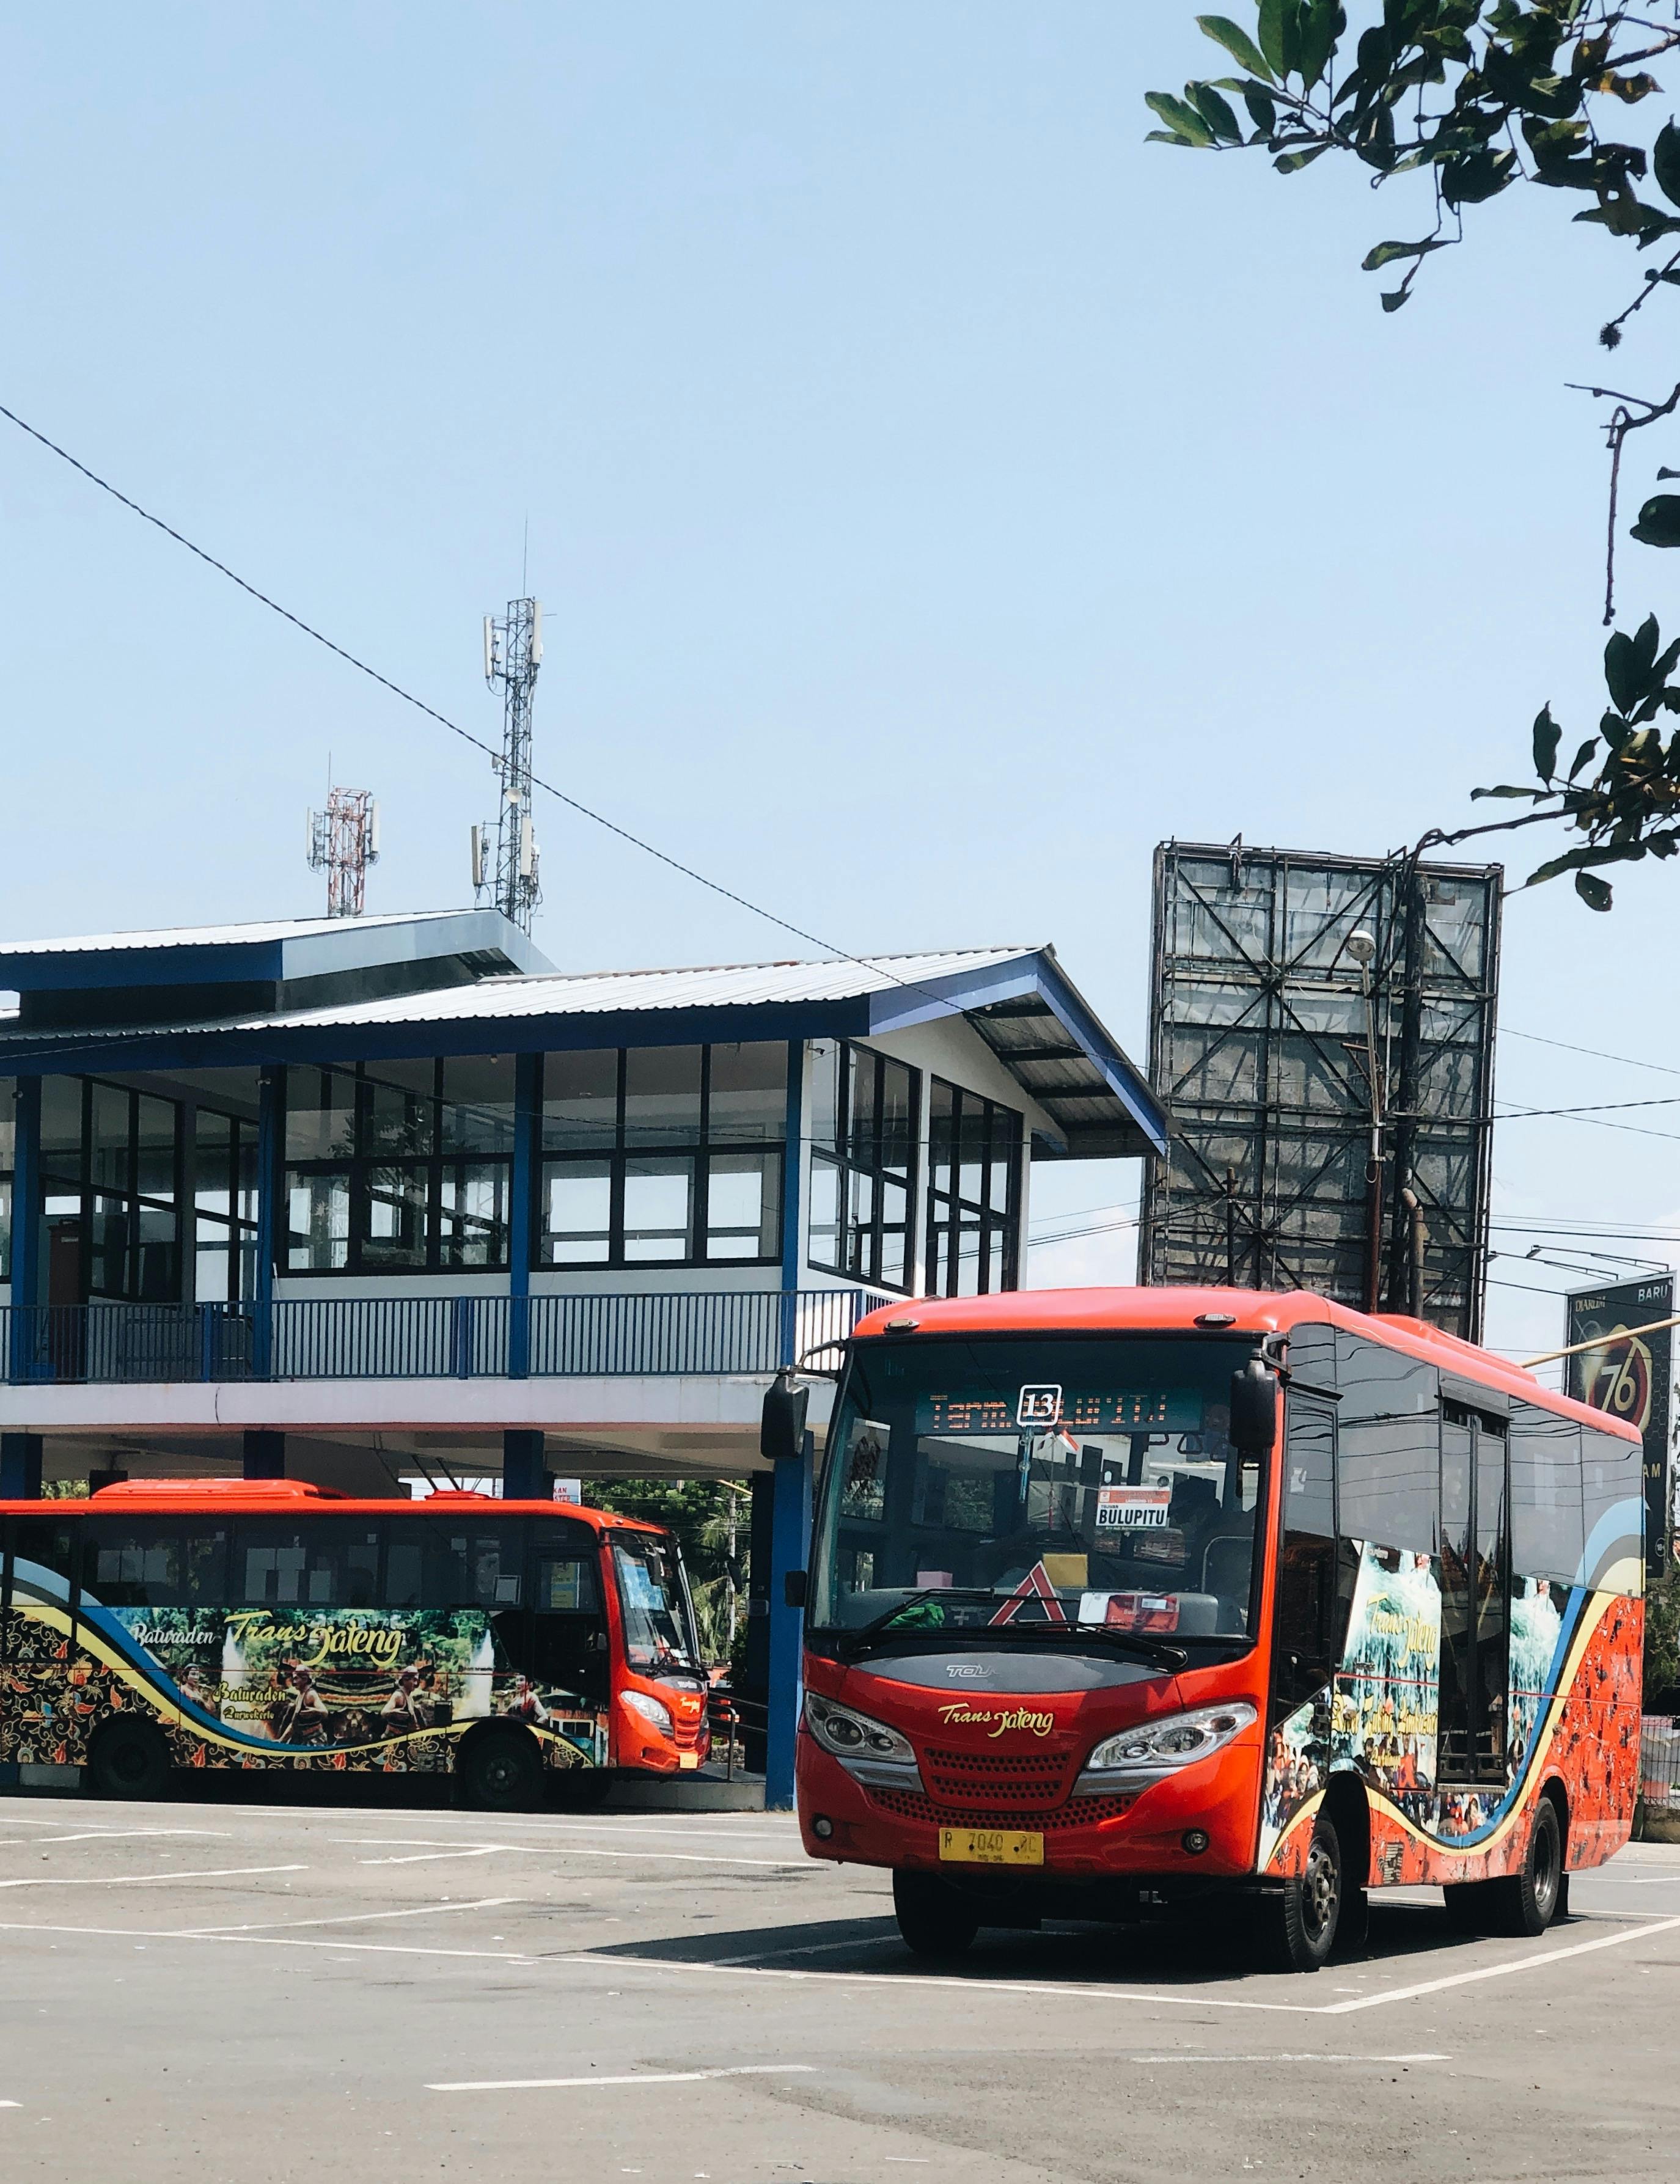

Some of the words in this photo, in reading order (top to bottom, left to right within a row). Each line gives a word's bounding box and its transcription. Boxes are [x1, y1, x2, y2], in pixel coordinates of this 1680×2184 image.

[1575, 1295, 1606, 1312] DJARUM
[1638, 1284, 1668, 1302] BARU
[1601, 1342, 1636, 1412] 76
[1025, 1393, 1054, 1417] 13
[1099, 1509, 1165, 1525] BULUPITU
[1367, 1592, 1406, 1635] Trans
[224, 1610, 307, 1642] Trans
[306, 1618, 406, 1666] Jateng
[938, 1702, 992, 1724] Trans
[987, 1707, 1054, 1737] Jateng
[945, 1831, 952, 1848] R
[968, 1833, 1003, 1851] 7040
